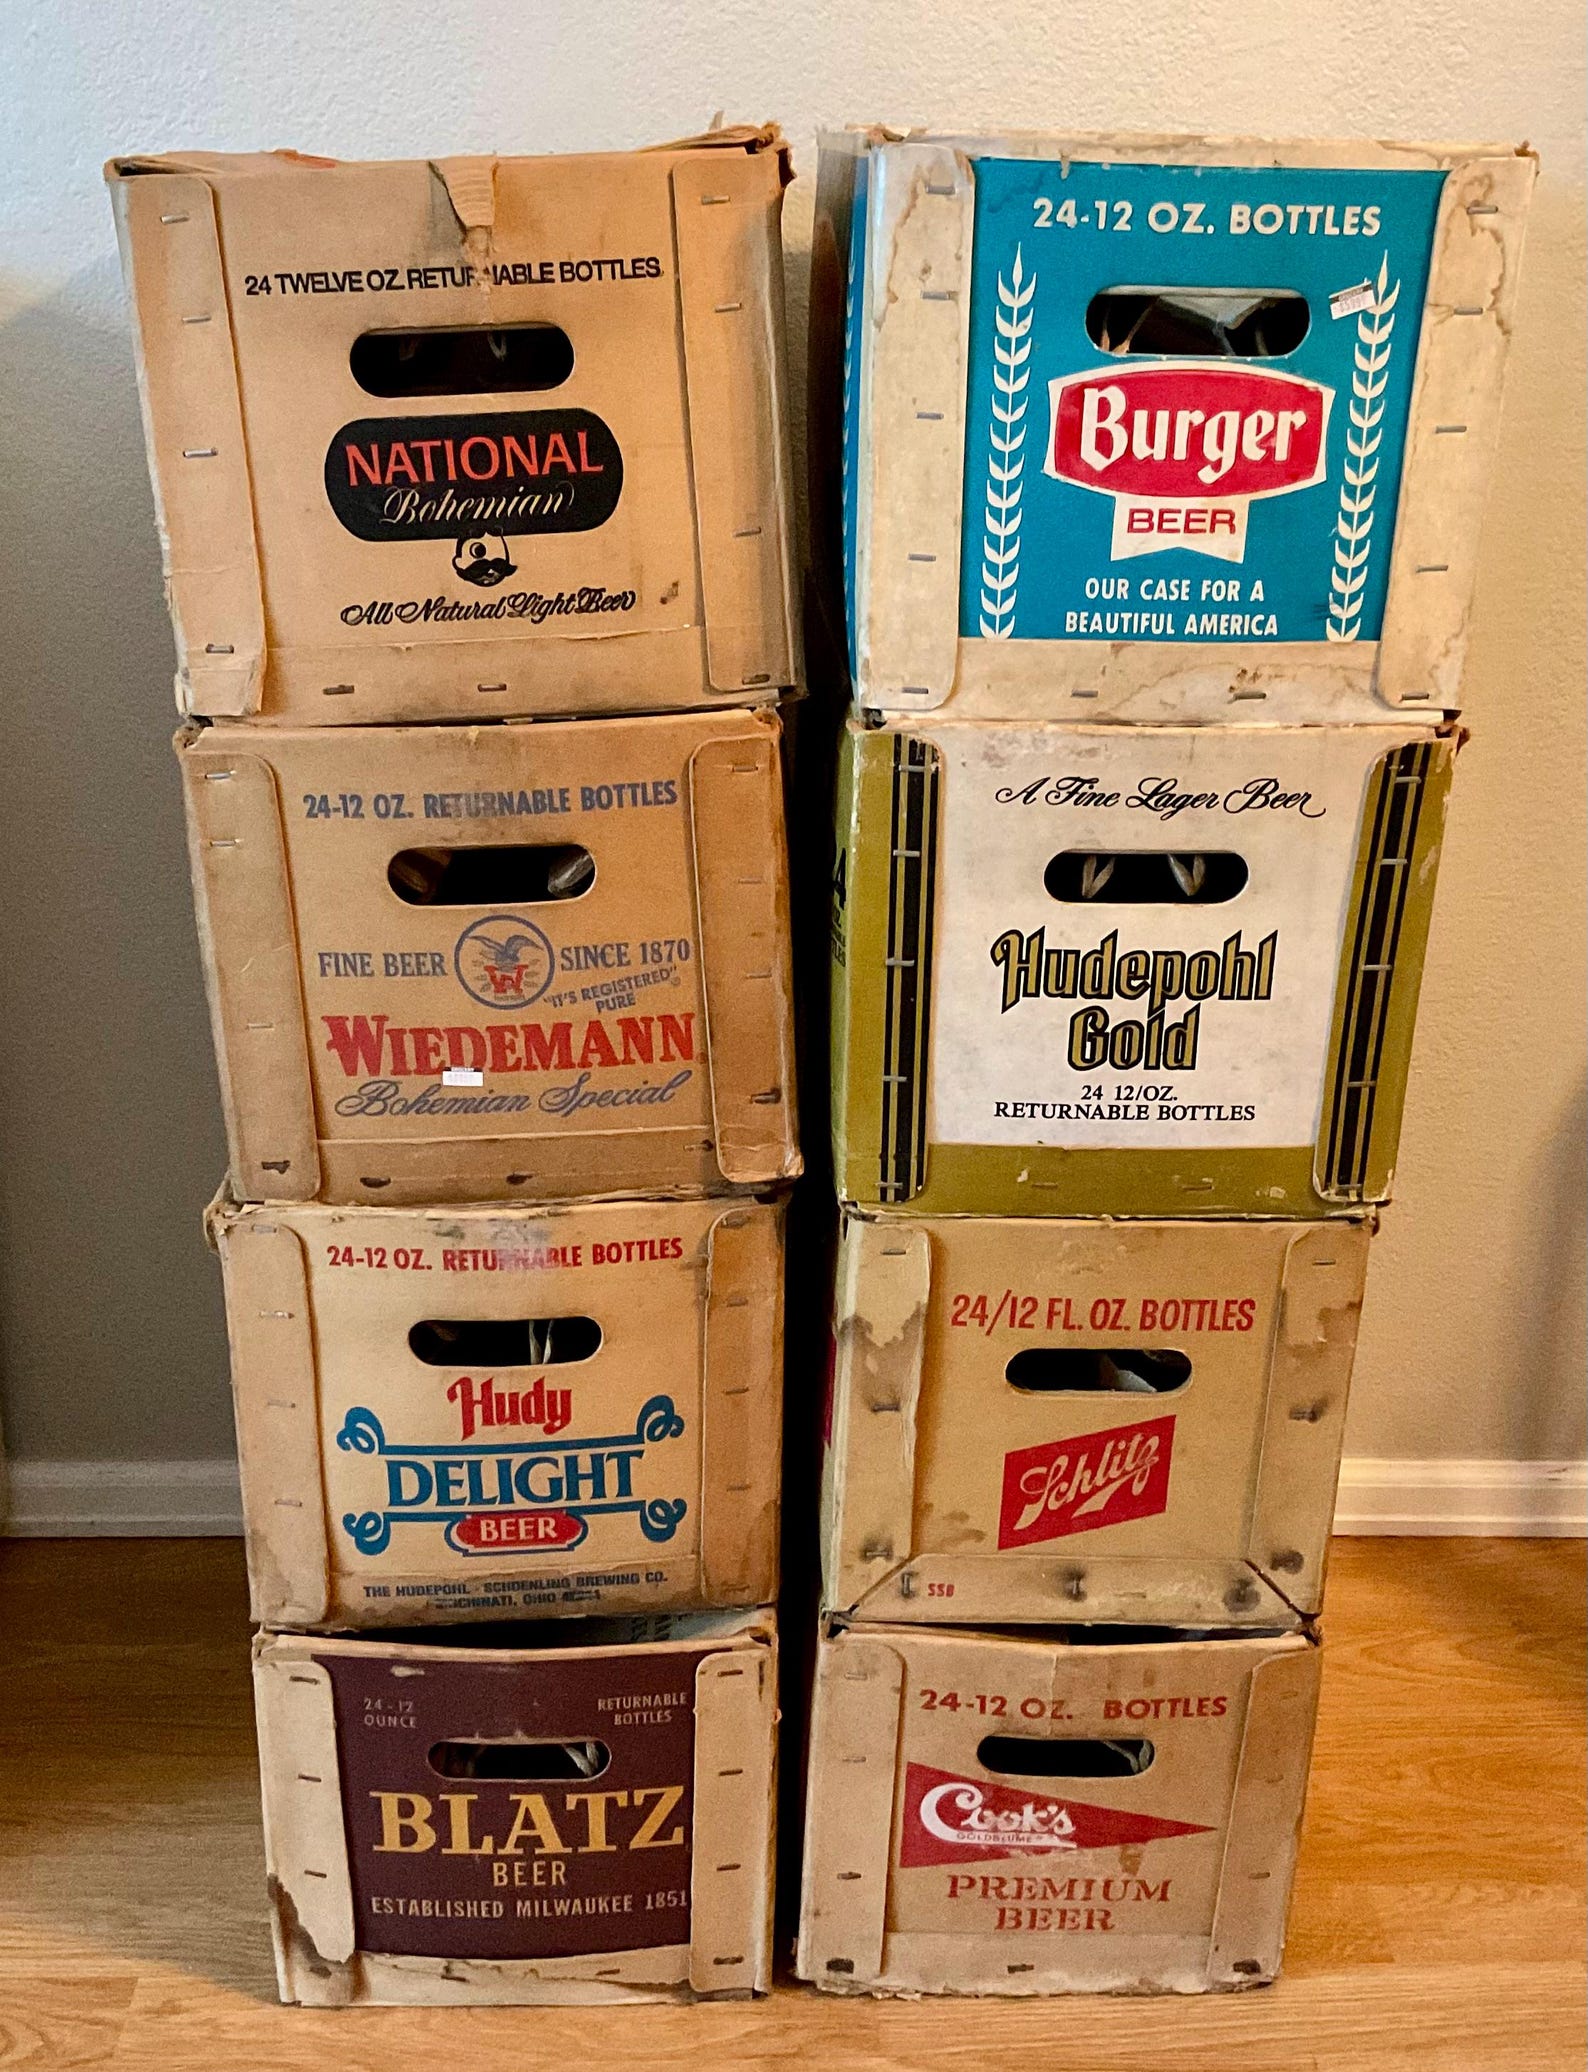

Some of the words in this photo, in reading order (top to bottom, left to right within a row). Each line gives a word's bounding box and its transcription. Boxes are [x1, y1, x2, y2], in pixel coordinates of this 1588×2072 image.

[1033, 197, 1132, 233] 24-12
[1147, 203, 1214, 236] OZ.
[1229, 203, 1381, 238] BOTTLES
[245, 275, 272, 296] 24
[275, 271, 364, 295] TWELVE
[1078, 386, 1306, 484] Burger
[345, 430, 602, 487] NATIONAL
[380, 483, 574, 525] Bohemian
[1127, 507, 1236, 536] BEER
[340, 601, 394, 626] All
[395, 596, 508, 624] Natural
[506, 592, 576, 625] Light
[574, 587, 637, 614] Beer
[1084, 577, 1131, 602] OUR
[1139, 578, 1190, 602] CASE
[1201, 578, 1241, 603] FOR
[1249, 579, 1265, 603] A
[1065, 610, 1175, 635] BEAUTIFUL
[1185, 611, 1278, 636] AMERICA
[302, 793, 364, 819] 24-12
[373, 793, 414, 819] OZ.
[423, 788, 571, 819] RETURNABLE
[580, 780, 678, 812] BOTTLES
[995, 777, 1050, 806] A
[1044, 776, 1119, 808] Fine
[1126, 777, 1220, 821] Lager
[1224, 778, 1326, 818] Beer
[318, 952, 374, 978] FINE
[383, 951, 448, 978] BEER
[560, 942, 631, 972] SINCE
[639, 938, 690, 965] 1870
[990, 926, 1278, 1015] Hudepohl
[595, 993, 636, 1014] PURE
[322, 1011, 696, 1077] WIEDEMANN
[1067, 1003, 1201, 1071] Gold
[335, 1078, 531, 1118] Bohemian
[538, 1069, 693, 1113] Special
[1081, 1085, 1104, 1101] 24
[1115, 1083, 1178, 1102] 12/OZ.
[994, 1102, 1149, 1122] RETURNABLE
[1156, 1103, 1256, 1123] BOTTLES
[327, 1245, 389, 1270] 24-12
[393, 1247, 433, 1271] OZ.
[592, 1237, 683, 1265] BOTTLES
[951, 1289, 1036, 1337] 24/12
[1046, 1295, 1083, 1330] FL.
[1090, 1298, 1131, 1332] OZ.
[1139, 1298, 1256, 1332] BOTTLES
[446, 1376, 572, 1441] Hudy
[386, 1449, 645, 1507] DELIGHT
[1013, 1432, 1159, 1531] Schlitz
[480, 1516, 558, 1542] BEER
[363, 1585, 391, 1598] THE
[576, 1573, 640, 1588] BREWING
[645, 1571, 668, 1583] CO.
[598, 1692, 687, 1711] RETURNABLE
[614, 1709, 672, 1726] BOTTLES
[919, 1689, 1007, 1717] 24-12
[1020, 1697, 1073, 1721] OZ.
[1103, 1696, 1228, 1721] BOTTLES
[364, 1714, 416, 1728] OUNCE
[369, 1785, 684, 1855] BLATZ
[920, 1782, 1077, 1849] Cook's
[492, 1860, 567, 1887] BEER
[947, 1874, 1172, 1903] PREMIUM
[372, 1897, 504, 1918] ESTABLISHED
[516, 1894, 633, 1918] MILWAUKEE
[645, 1890, 687, 1911] 1851
[994, 1907, 1116, 1931] BEER
